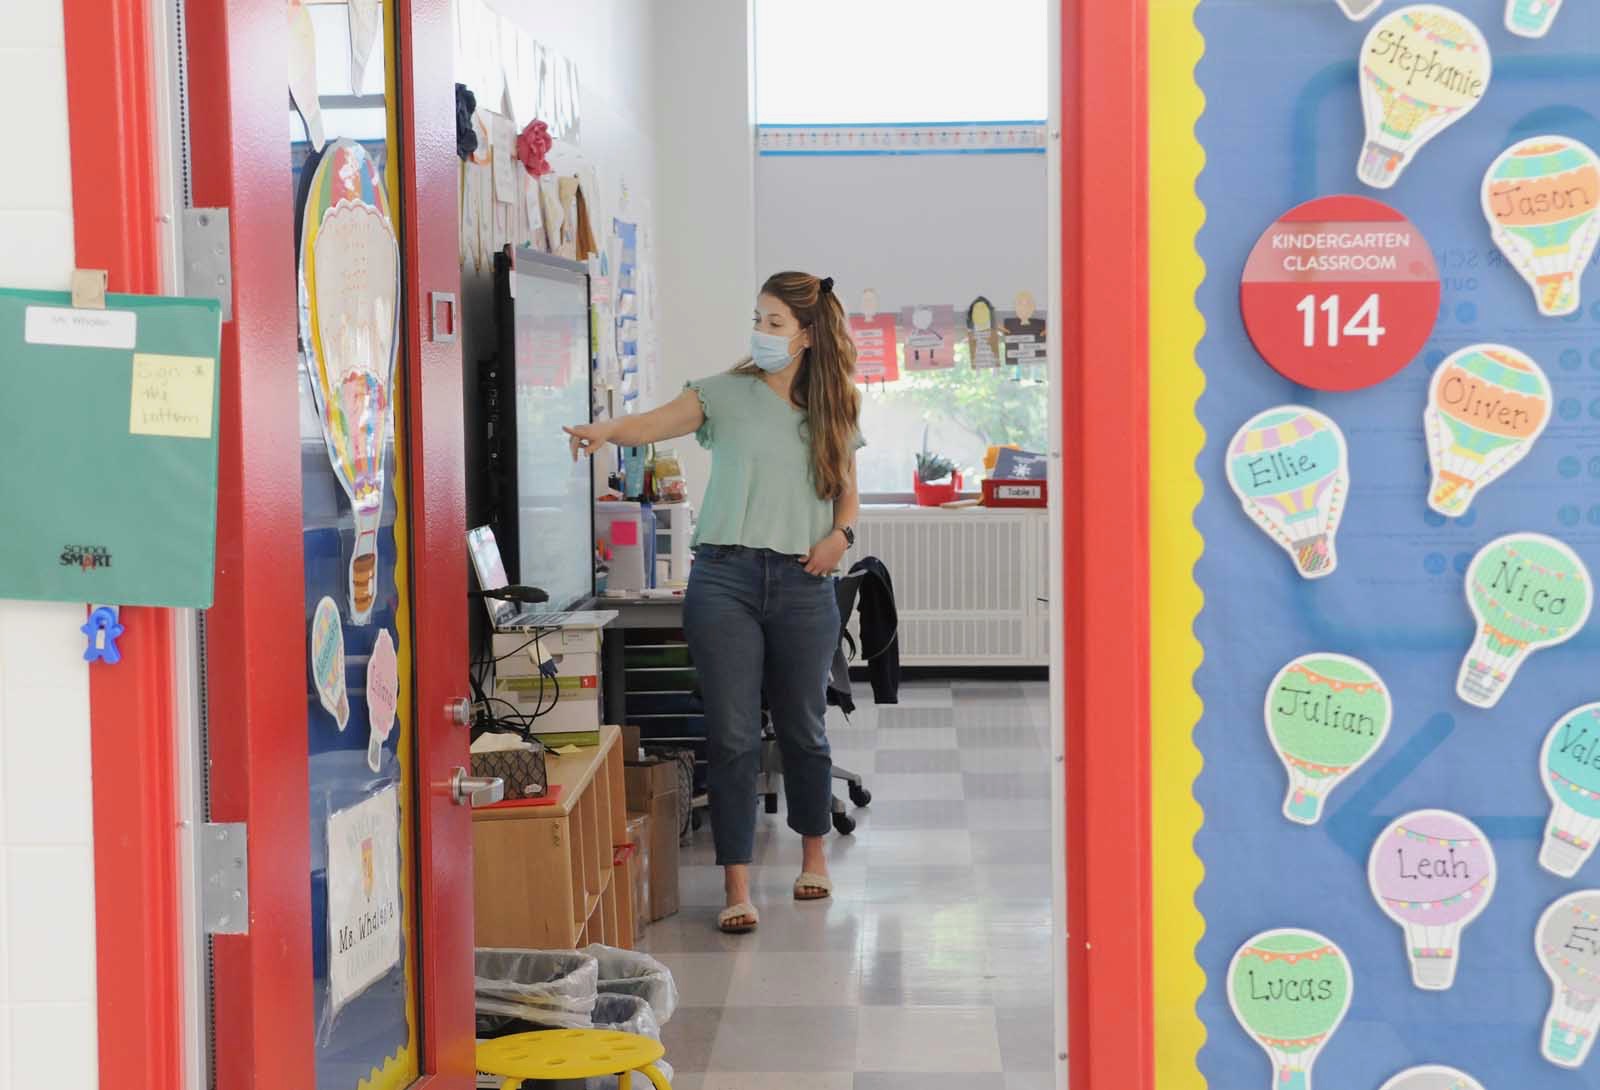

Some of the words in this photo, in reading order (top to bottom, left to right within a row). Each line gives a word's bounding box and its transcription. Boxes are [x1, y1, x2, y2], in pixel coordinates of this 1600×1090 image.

[1370, 29, 1483, 99] Stephanie
[1493, 186, 1590, 217] Jason
[1272, 233, 1411, 249] KINDERGARTEN
[1283, 255, 1397, 271] CLASSROOM
[1296, 293, 1386, 347] 114
[1443, 377, 1529, 430] Oliver
[1248, 451, 1317, 488] Ellie
[63, 544, 108, 554] SCHOOL
[1490, 560, 1567, 616] Nico
[1278, 686, 1375, 736] Julian
[1397, 848, 1470, 880] Leah
[1248, 970, 1332, 1001] Lucas
